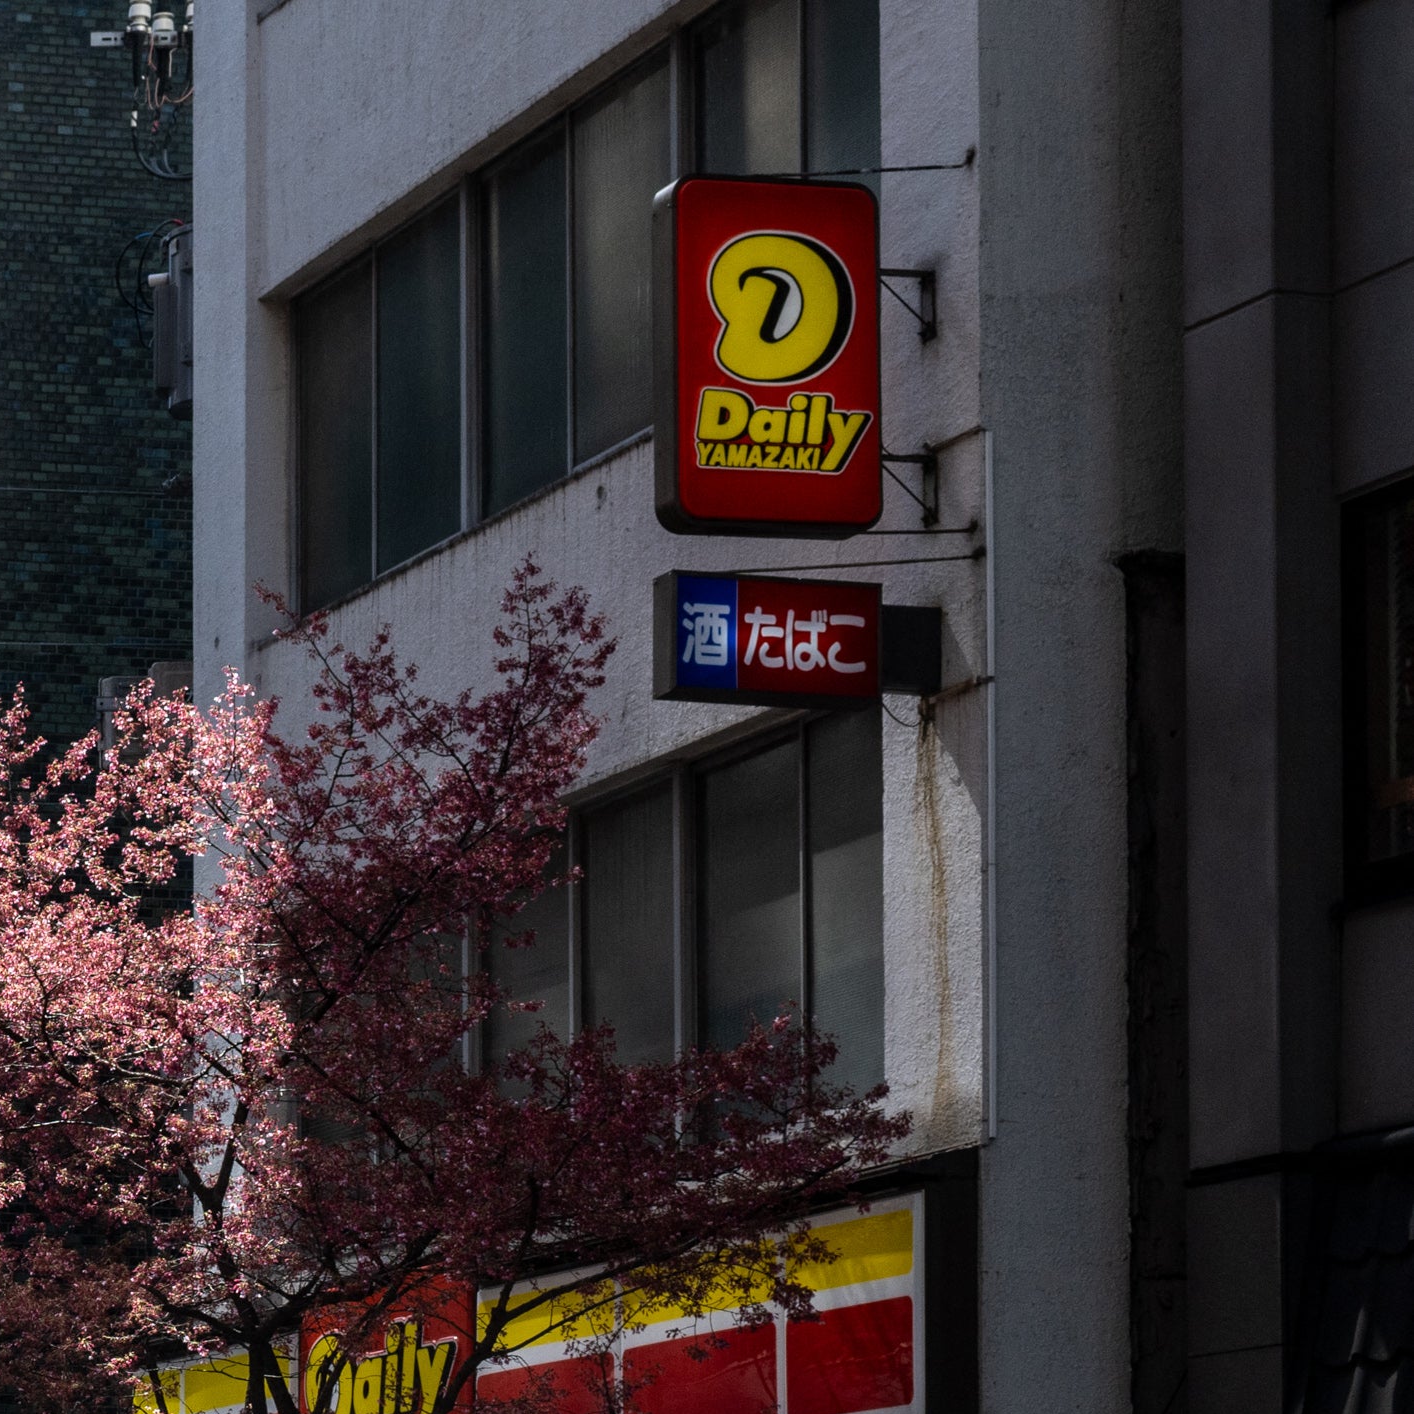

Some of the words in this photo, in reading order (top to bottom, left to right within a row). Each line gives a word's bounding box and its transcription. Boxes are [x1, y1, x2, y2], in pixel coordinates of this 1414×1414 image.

[697, 389, 872, 472] Daily
[697, 443, 824, 470] YAMAZAKI
[682, 601, 731, 667] 酒
[743, 606, 867, 675] たばこ
